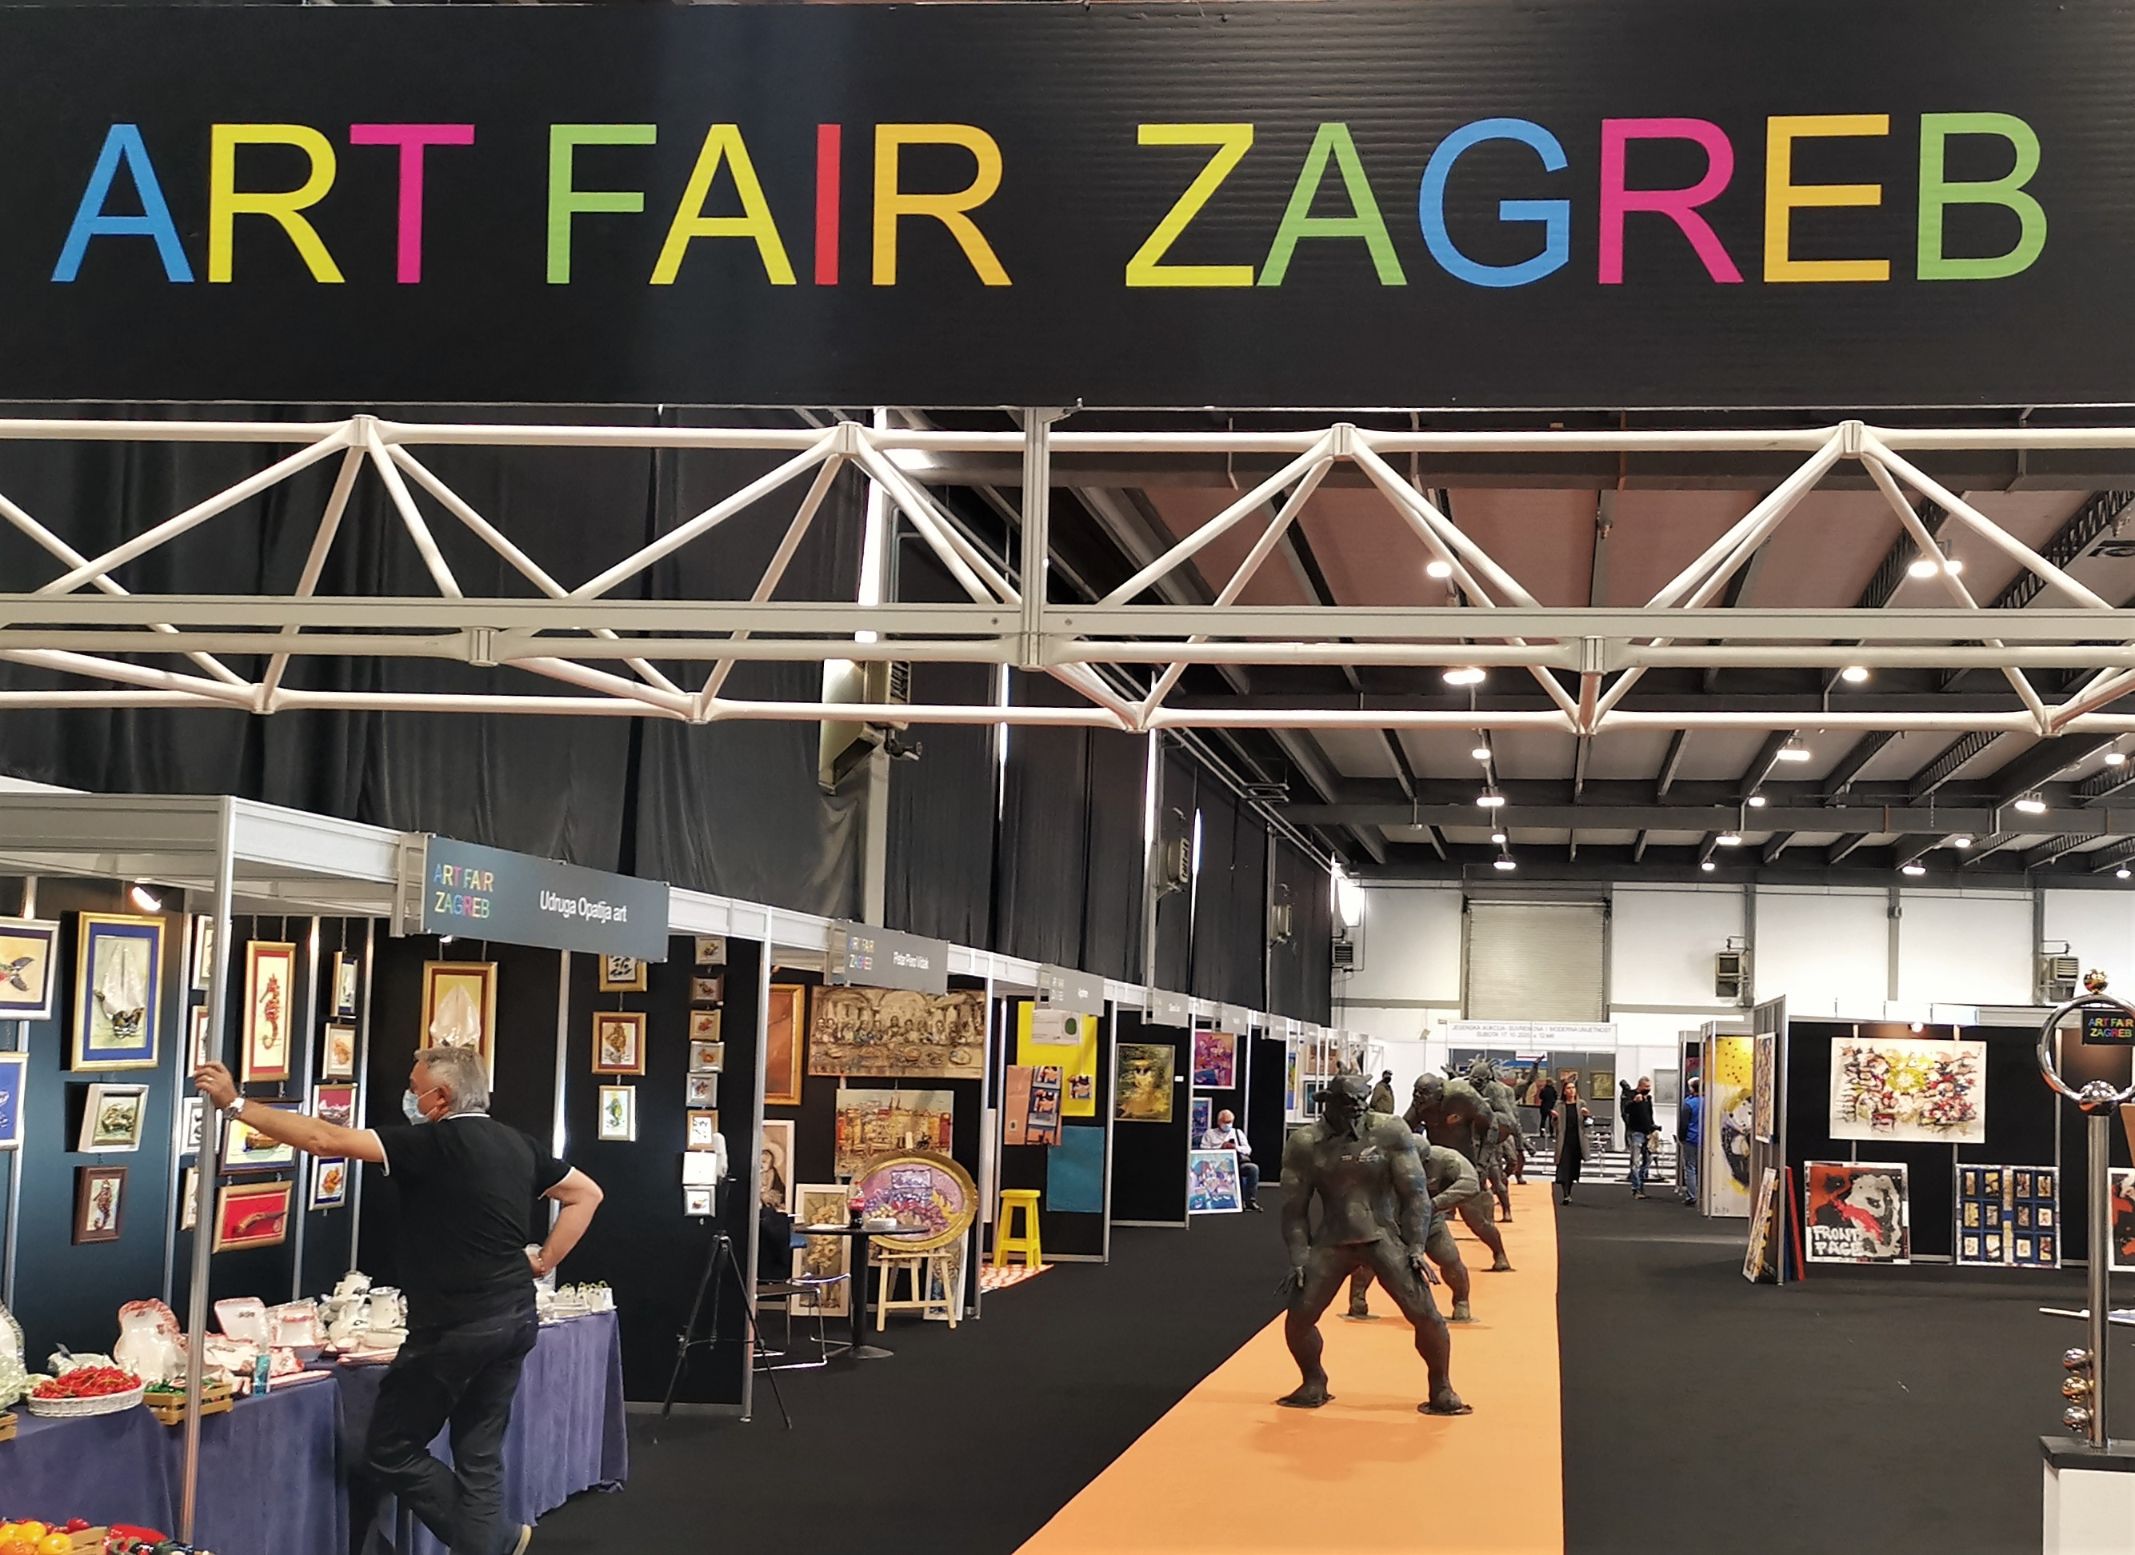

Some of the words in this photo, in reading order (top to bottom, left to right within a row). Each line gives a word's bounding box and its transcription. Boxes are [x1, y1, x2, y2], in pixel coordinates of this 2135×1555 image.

[52, 123, 475, 284] ART
[548, 122, 1013, 287] FAIR
[1126, 113, 2047, 288] ZAGREB
[434, 863, 461, 887] ART
[463, 868, 494, 892] FAIR
[434, 891, 490, 919] ZAGREB
[540, 889, 576, 918] Udruga
[578, 896, 613, 923] Opatija
[613, 904, 627, 922] art
[2088, 1017, 2109, 1027] ART
[2110, 1017, 2134, 1027] FAIR
[2090, 1027, 2132, 1038] ZAGREB
[1811, 1225, 1860, 1242] FRONT
[1814, 1240, 1864, 1257] PAGE
